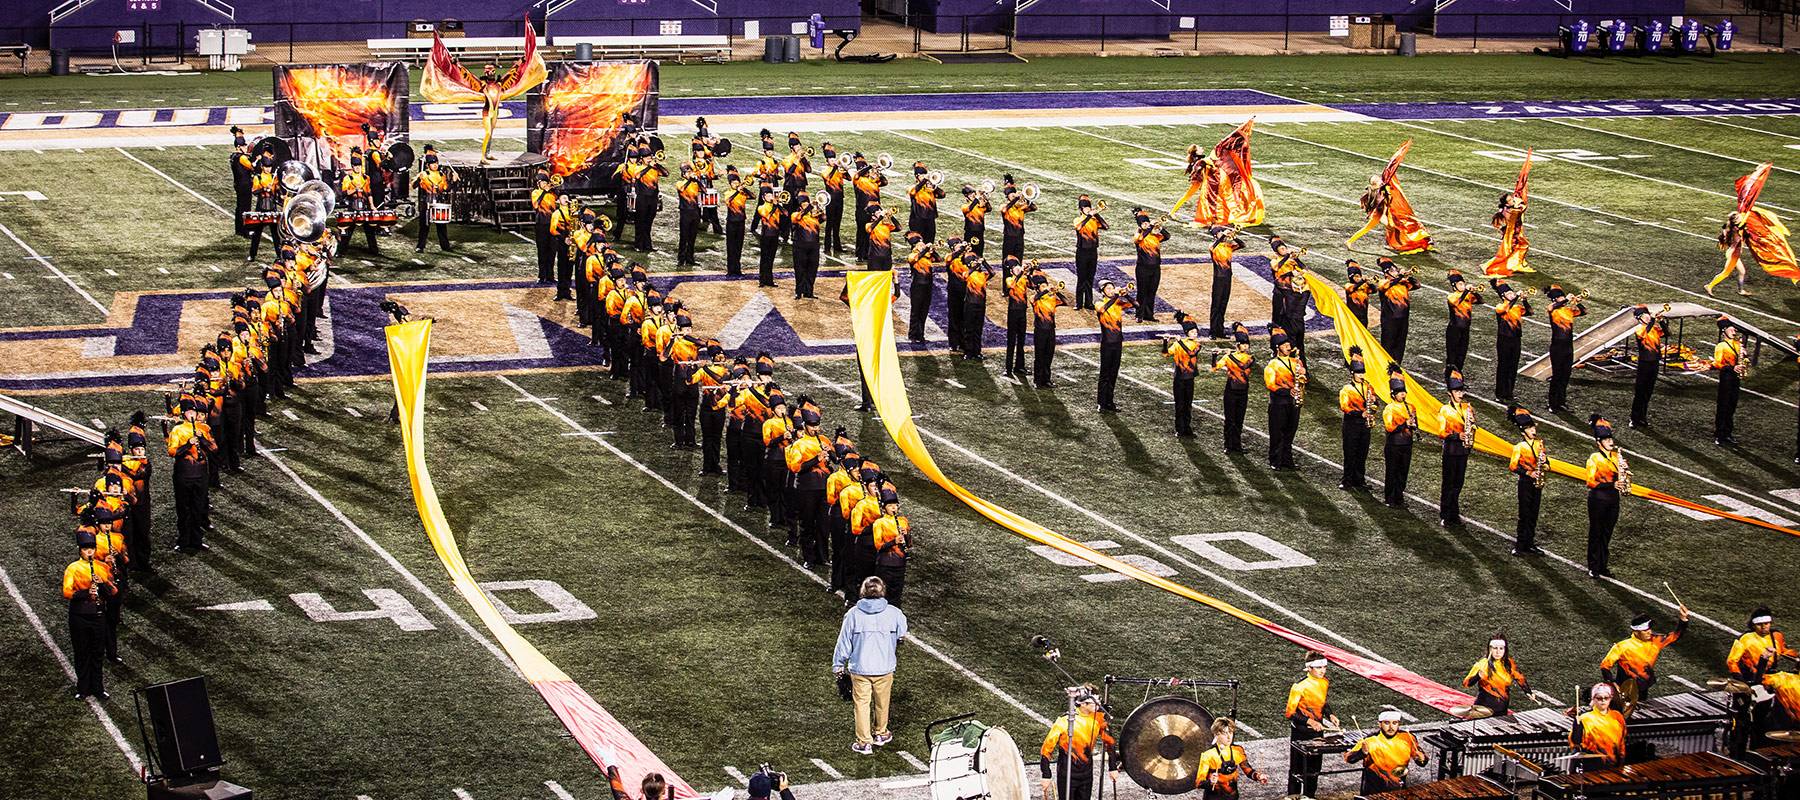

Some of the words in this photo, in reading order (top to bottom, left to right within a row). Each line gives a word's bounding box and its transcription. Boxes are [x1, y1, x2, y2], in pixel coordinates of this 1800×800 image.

[131, 2, 137, 10] 4
[140, 2, 148, 10] &
[151, 2, 158, 10] 5
[1577, 33, 1588, 42] 70
[1615, 33, 1626, 42] 70
[1651, 33, 1662, 42] 70
[1687, 32, 1698, 41] 70
[1721, 32, 1732, 41] 70
[1470, 104, 1654, 115] ZANE
[1660, 102, 1800, 113] SHO
[289, 580, 599, 632] 40
